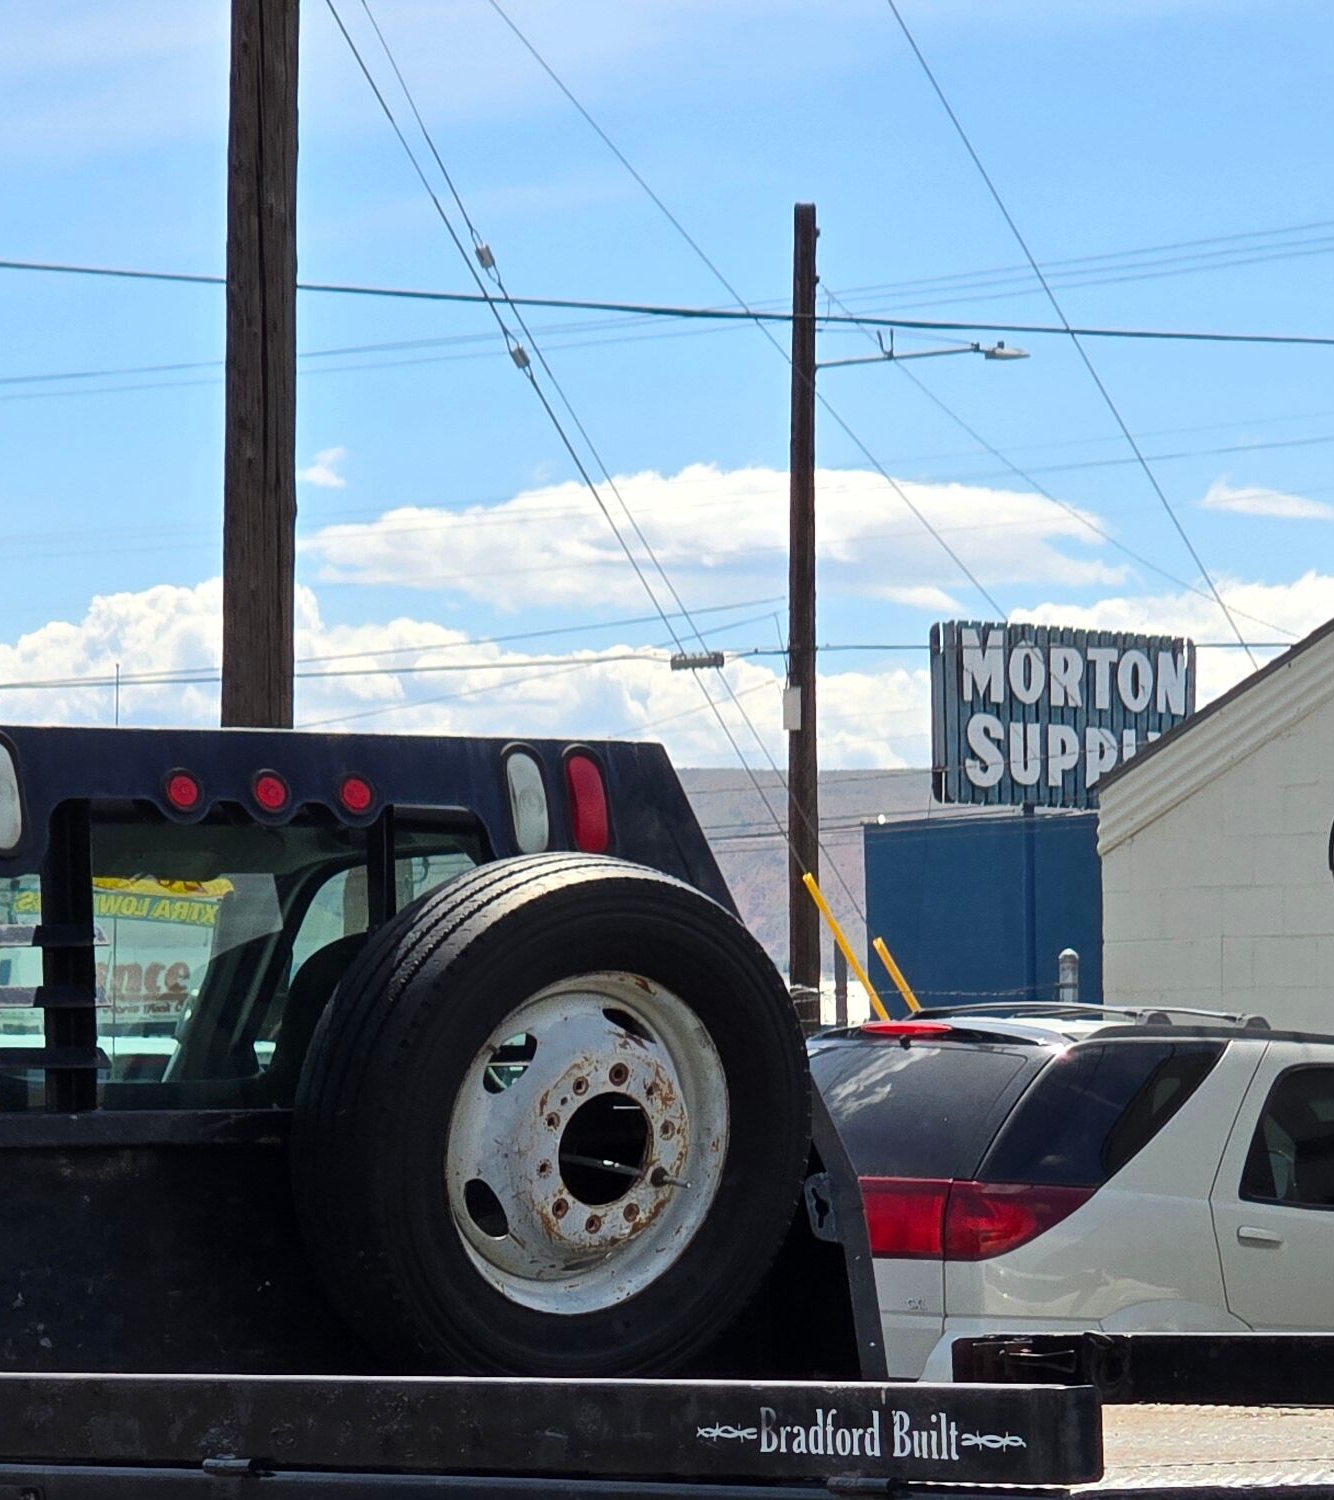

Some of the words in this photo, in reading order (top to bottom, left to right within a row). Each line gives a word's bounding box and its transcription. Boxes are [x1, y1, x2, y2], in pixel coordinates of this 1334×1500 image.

[962, 628, 1187, 715] MORTON
[965, 712, 1162, 789] SUPP
[760, 1407, 882, 1457] Bradford
[892, 1410, 960, 1461] Built
